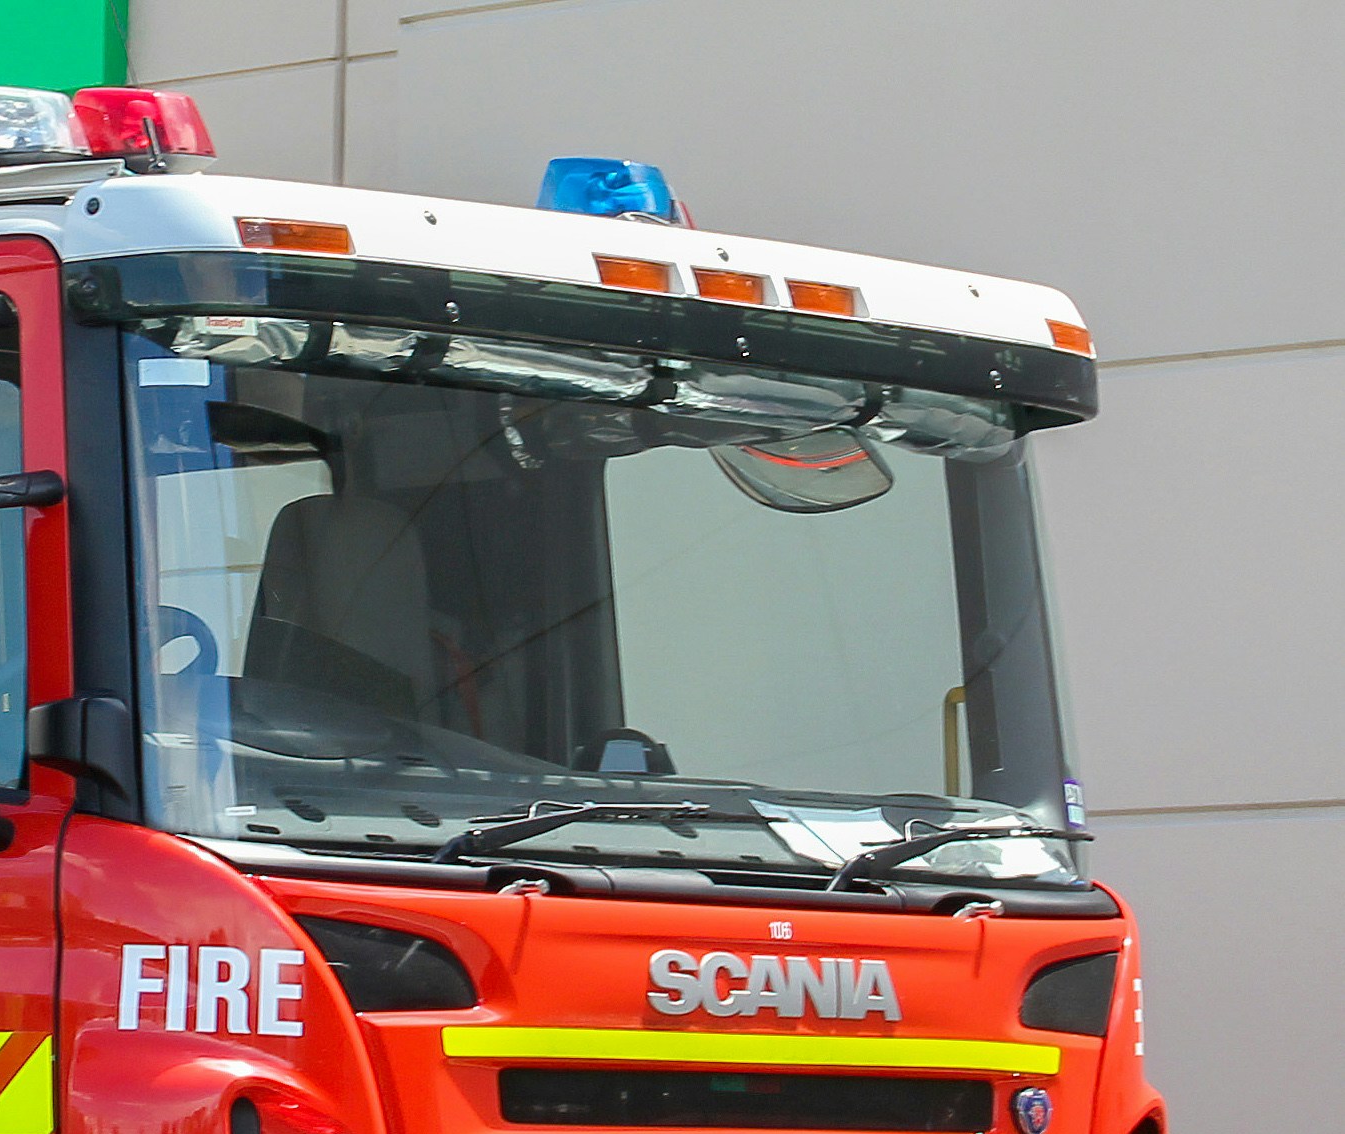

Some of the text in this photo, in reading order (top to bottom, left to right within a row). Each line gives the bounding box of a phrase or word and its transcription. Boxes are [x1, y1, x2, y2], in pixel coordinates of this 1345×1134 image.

[769, 921, 794, 940] 106
[117, 944, 305, 1037] FIRE
[647, 949, 902, 1021] SCANIA
